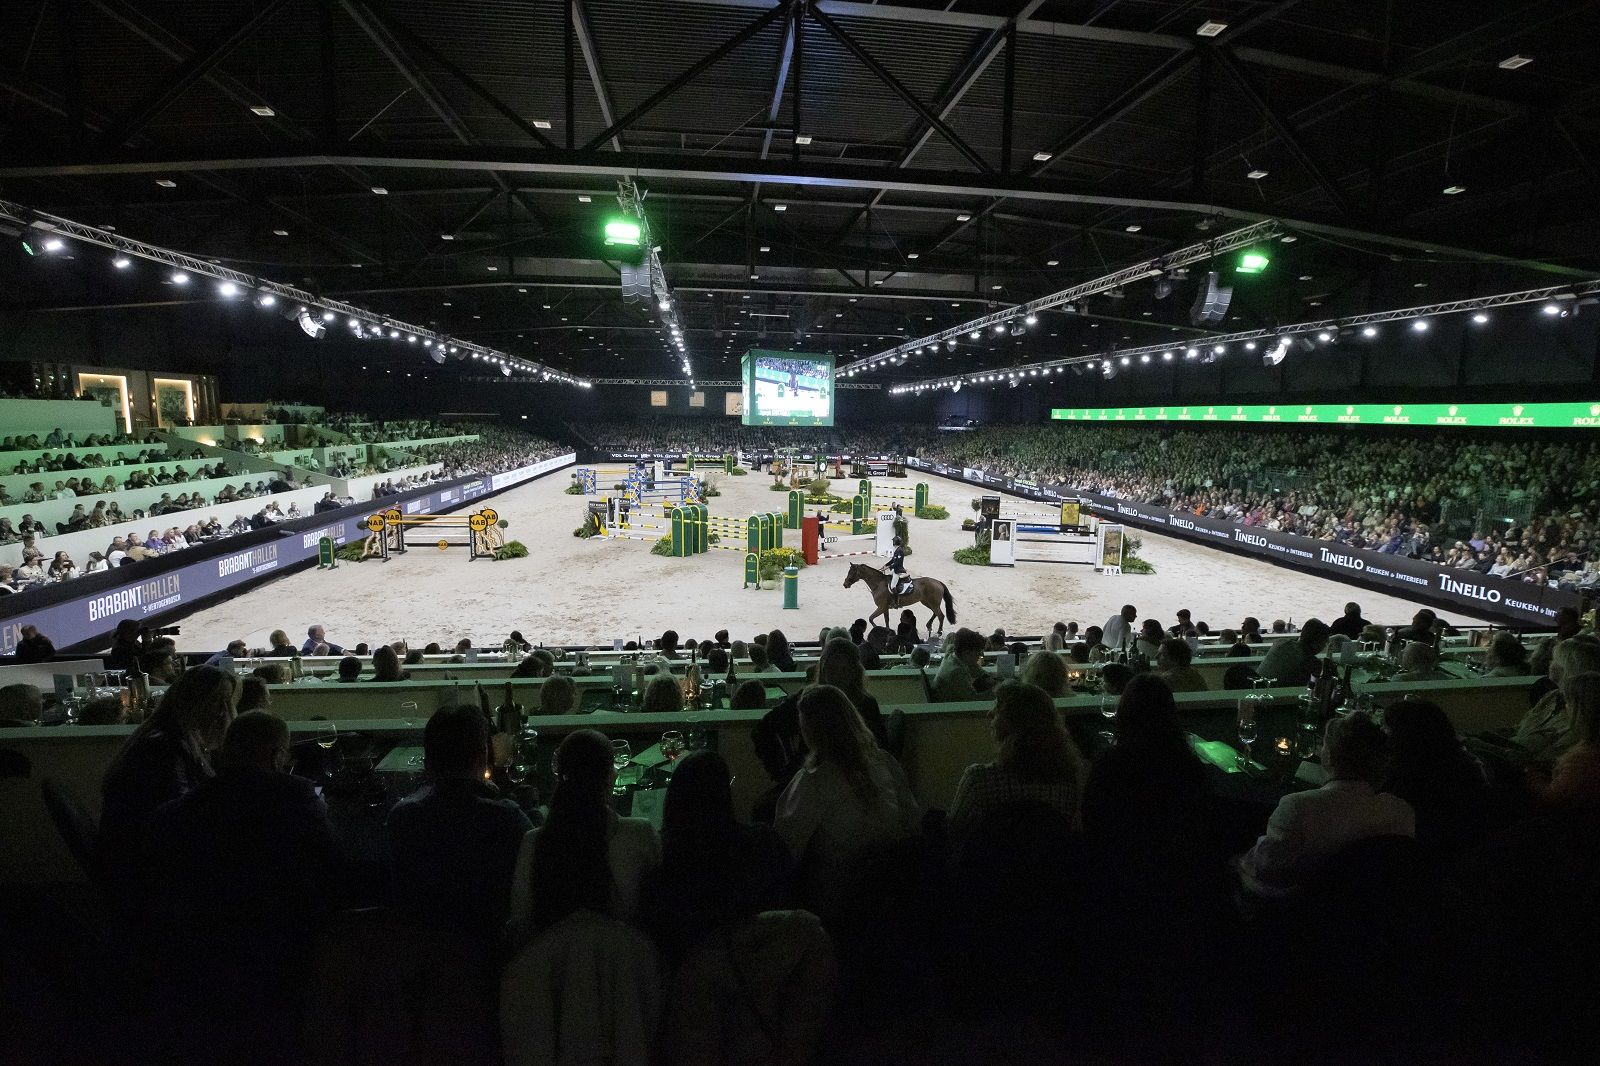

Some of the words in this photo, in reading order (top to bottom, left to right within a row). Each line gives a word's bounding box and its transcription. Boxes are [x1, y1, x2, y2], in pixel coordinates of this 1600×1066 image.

[1436, 416, 1467, 425] ROLEX
[1498, 417, 1534, 425] ROLEX
[1117, 503, 1138, 517] TINELLO
[1169, 514, 1194, 530] TINELLO
[1234, 528, 1267, 547] TINELLO
[1268, 543, 1285, 552] KEUKEN
[1289, 547, 1314, 559] INTERIEUR
[1320, 547, 1364, 570] TINELLO
[1365, 565, 1390, 577] KEUKEN
[1395, 572, 1428, 586] INTERIEUR
[88, 574, 181, 622] BRABANTHALLEN
[1439, 573, 1501, 603] TINELLO
[1505, 598, 1540, 613] KEUKEN
[1545, 607, 1557, 618] INT
